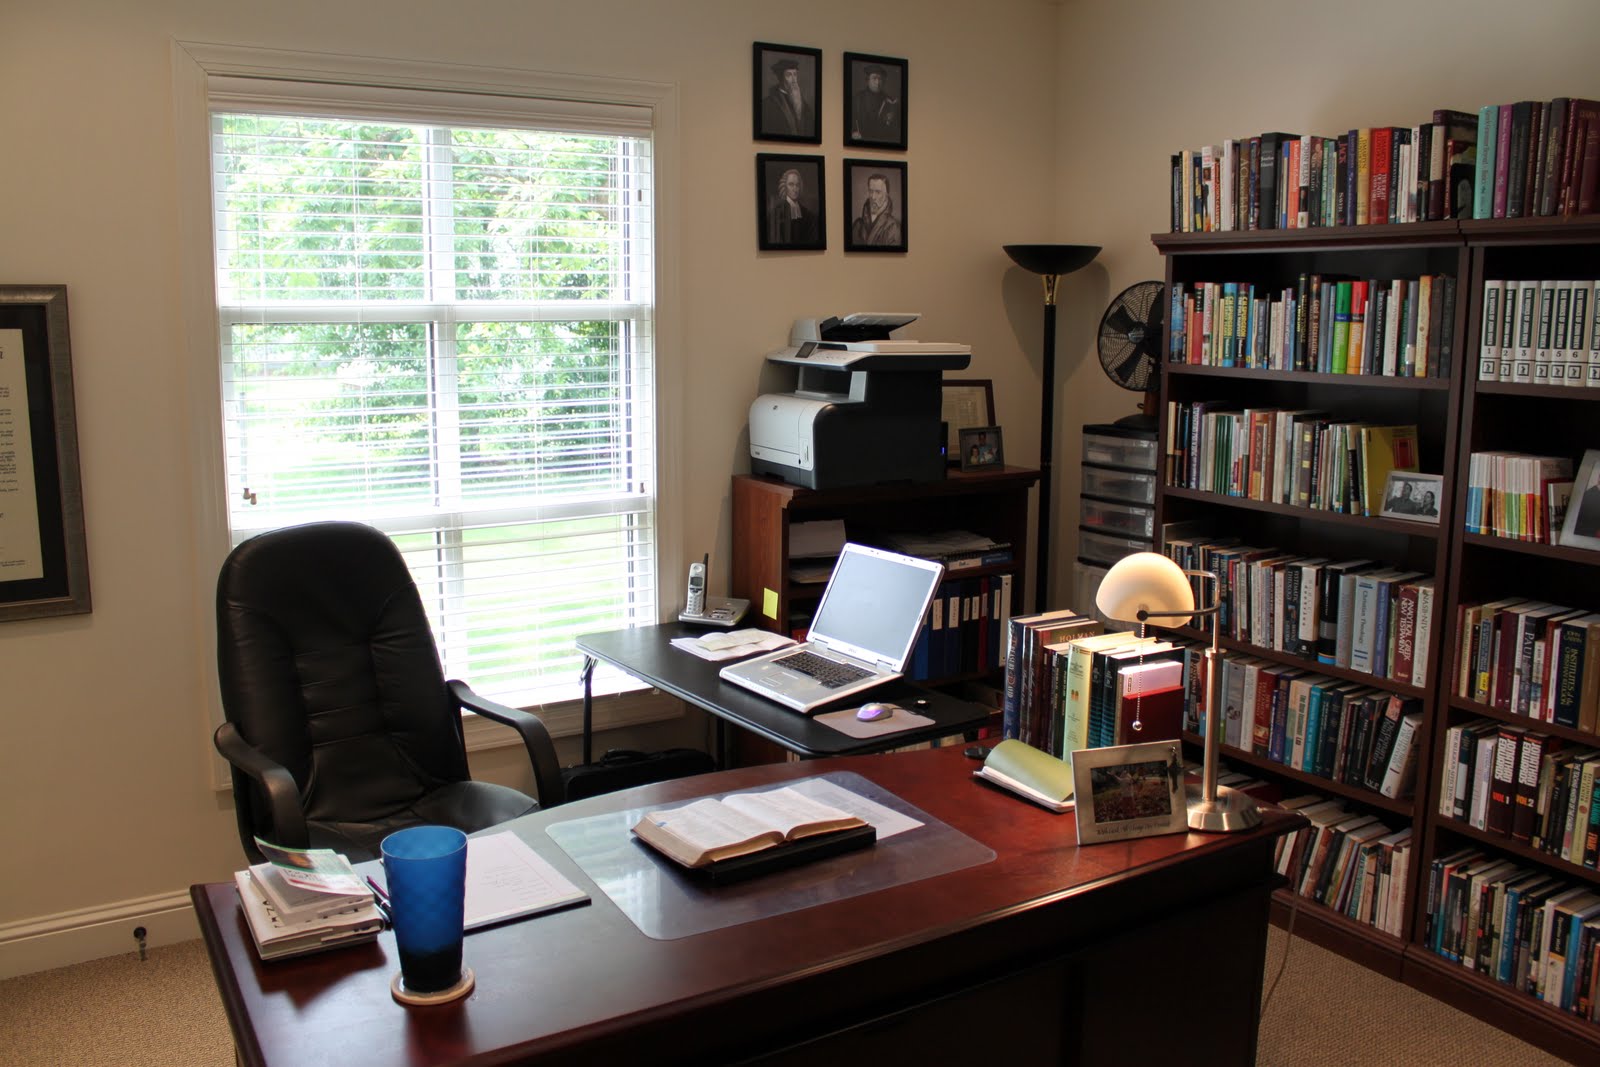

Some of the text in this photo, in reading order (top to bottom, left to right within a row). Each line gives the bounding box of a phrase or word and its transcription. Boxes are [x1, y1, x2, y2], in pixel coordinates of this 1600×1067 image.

[1358, 619, 1367, 644] Theology
[1398, 617, 1407, 655] TESTAMENT
[1404, 599, 1414, 661] ANALYTICAL GREEK
[1522, 632, 1534, 660] PAUL
[1562, 646, 1570, 677] CHRISTIAN
[1568, 648, 1579, 691] INSTITUTES
[1494, 737, 1507, 780] EDWARDS
[1502, 738, 1517, 784] JONATHAN
[1518, 741, 1532, 784] EDWARDS
[1527, 743, 1542, 788] JONATHAN
[1587, 832, 1598, 851] EVANS
